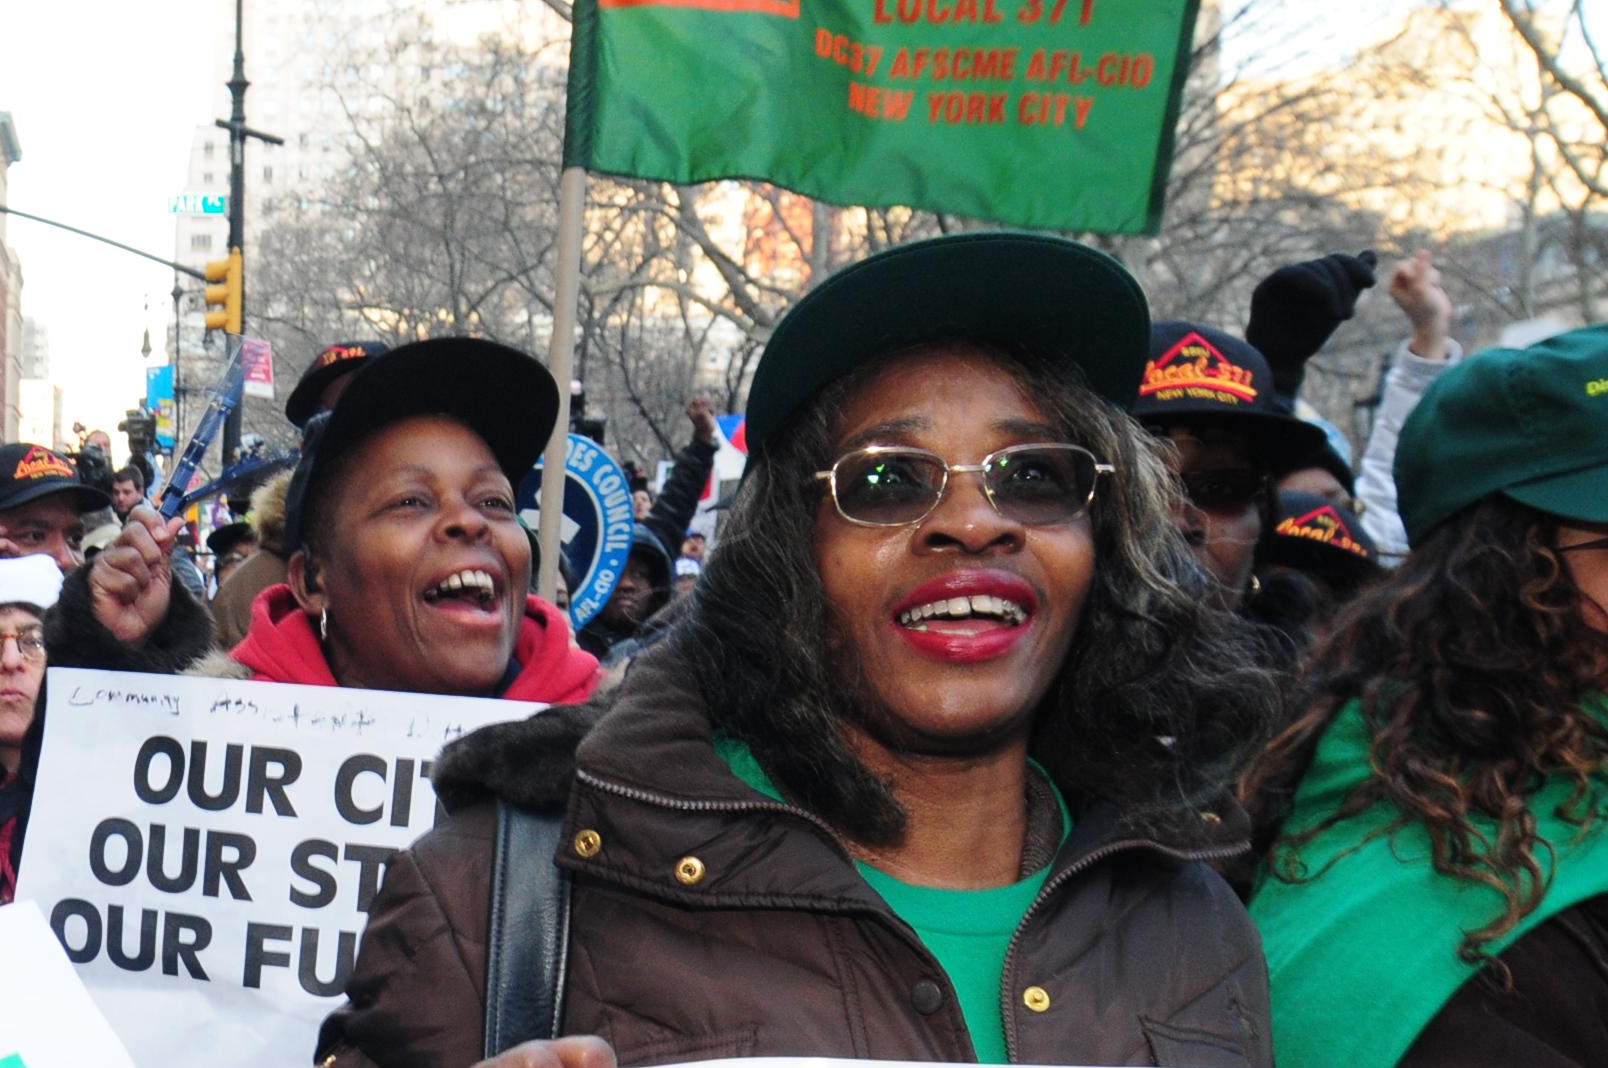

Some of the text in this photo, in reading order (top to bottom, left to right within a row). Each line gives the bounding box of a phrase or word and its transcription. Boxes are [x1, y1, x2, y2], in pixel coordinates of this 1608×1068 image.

[872, 0, 1004, 24] LOCAL
[816, 28, 1154, 88] DC37 AFSCME AFL-CIO
[848, 81, 1095, 129] NEW YORK CITY
[592, 464, 631, 553] COUNCIL
[133, 735, 302, 817] OUR
[89, 818, 256, 901] OUR
[50, 898, 212, 981] OUR
